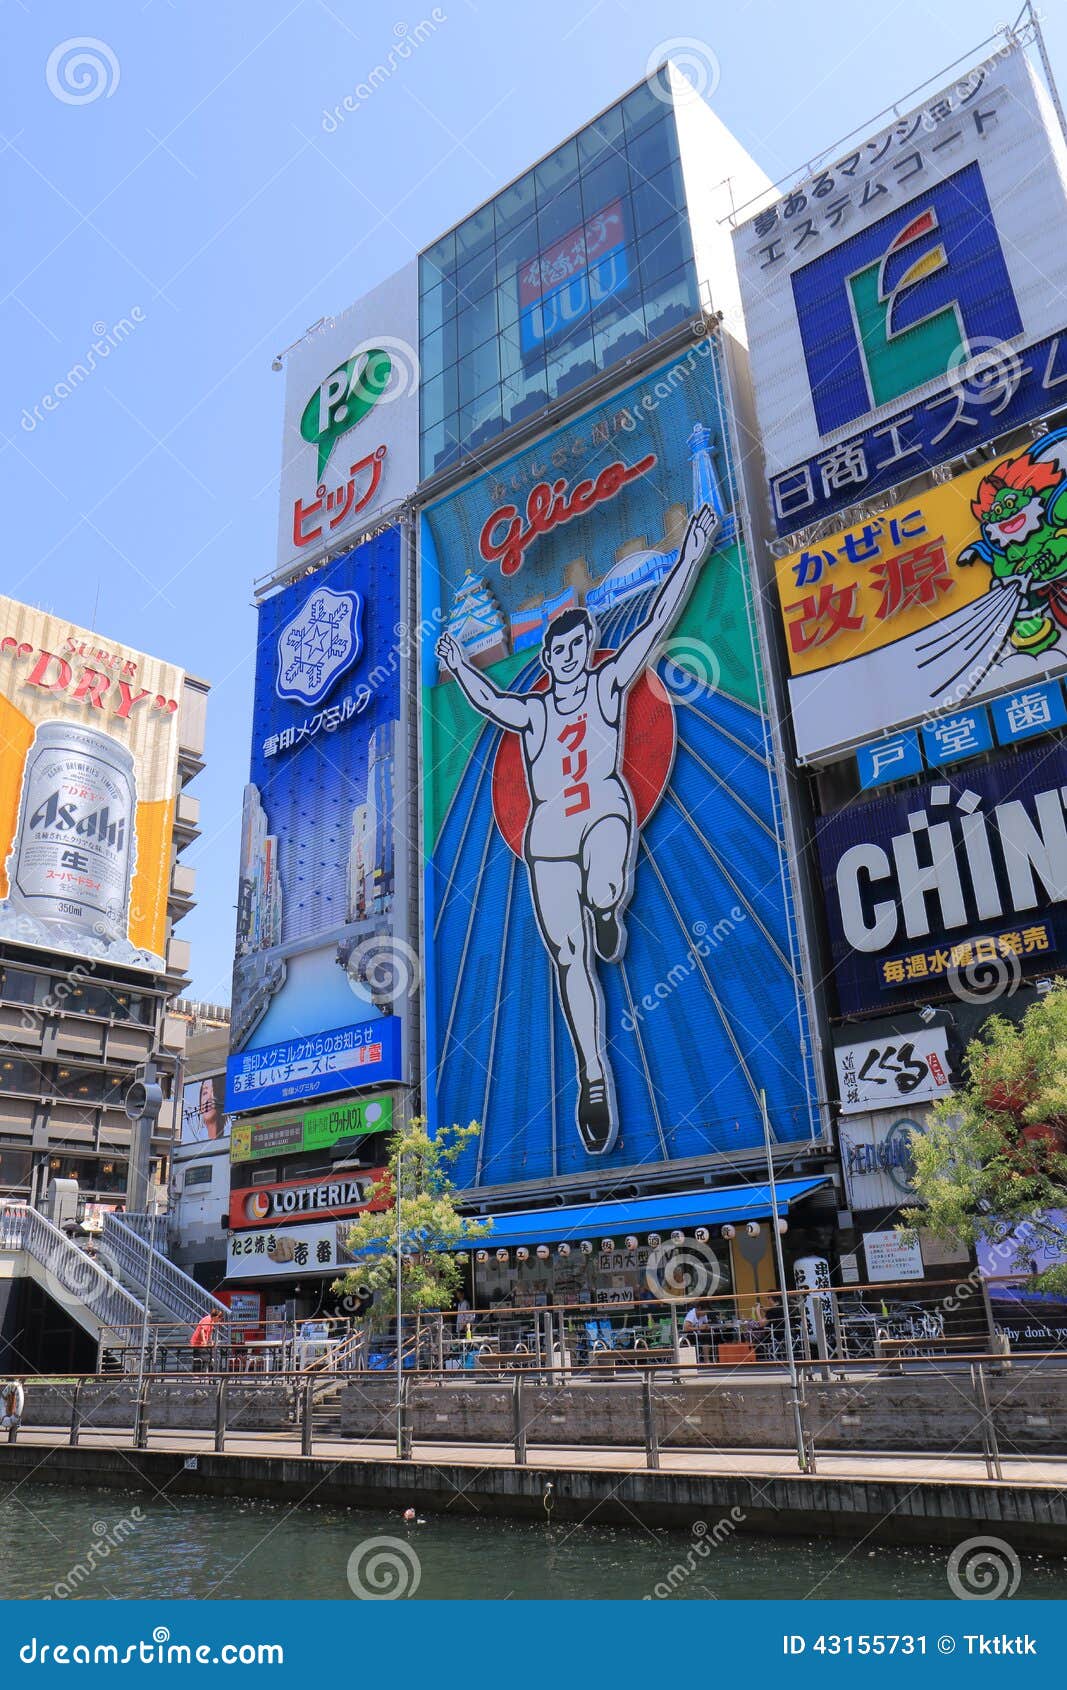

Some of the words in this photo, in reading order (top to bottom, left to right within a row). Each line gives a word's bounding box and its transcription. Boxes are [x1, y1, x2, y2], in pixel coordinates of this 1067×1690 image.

[759, 110, 997, 268] エステムコート
[293, 444, 388, 547] ピップ
[792, 510, 928, 589] かぜに
[784, 534, 956, 655] 改源
[64, 637, 137, 677] SUPER
[262, 689, 371, 758] 雪印メグミルク
[557, 704, 591, 818] グリコ
[30, 790, 125, 853] Asahi
[45, 868, 102, 890] スーパードライ
[61, 850, 89, 873] 生
[58, 902, 82, 917] 350ml
[883, 925, 1050, 983] 毎週水曜日発売
[242, 1026, 375, 1075] 雪印メグミルクからのお知らせ
[858, 1042, 929, 1094] くくる
[274, 1181, 361, 1212] LOTTERIA
[231, 1233, 277, 1257] たこ焼き
[1025, 1325, 1051, 1338] don't
